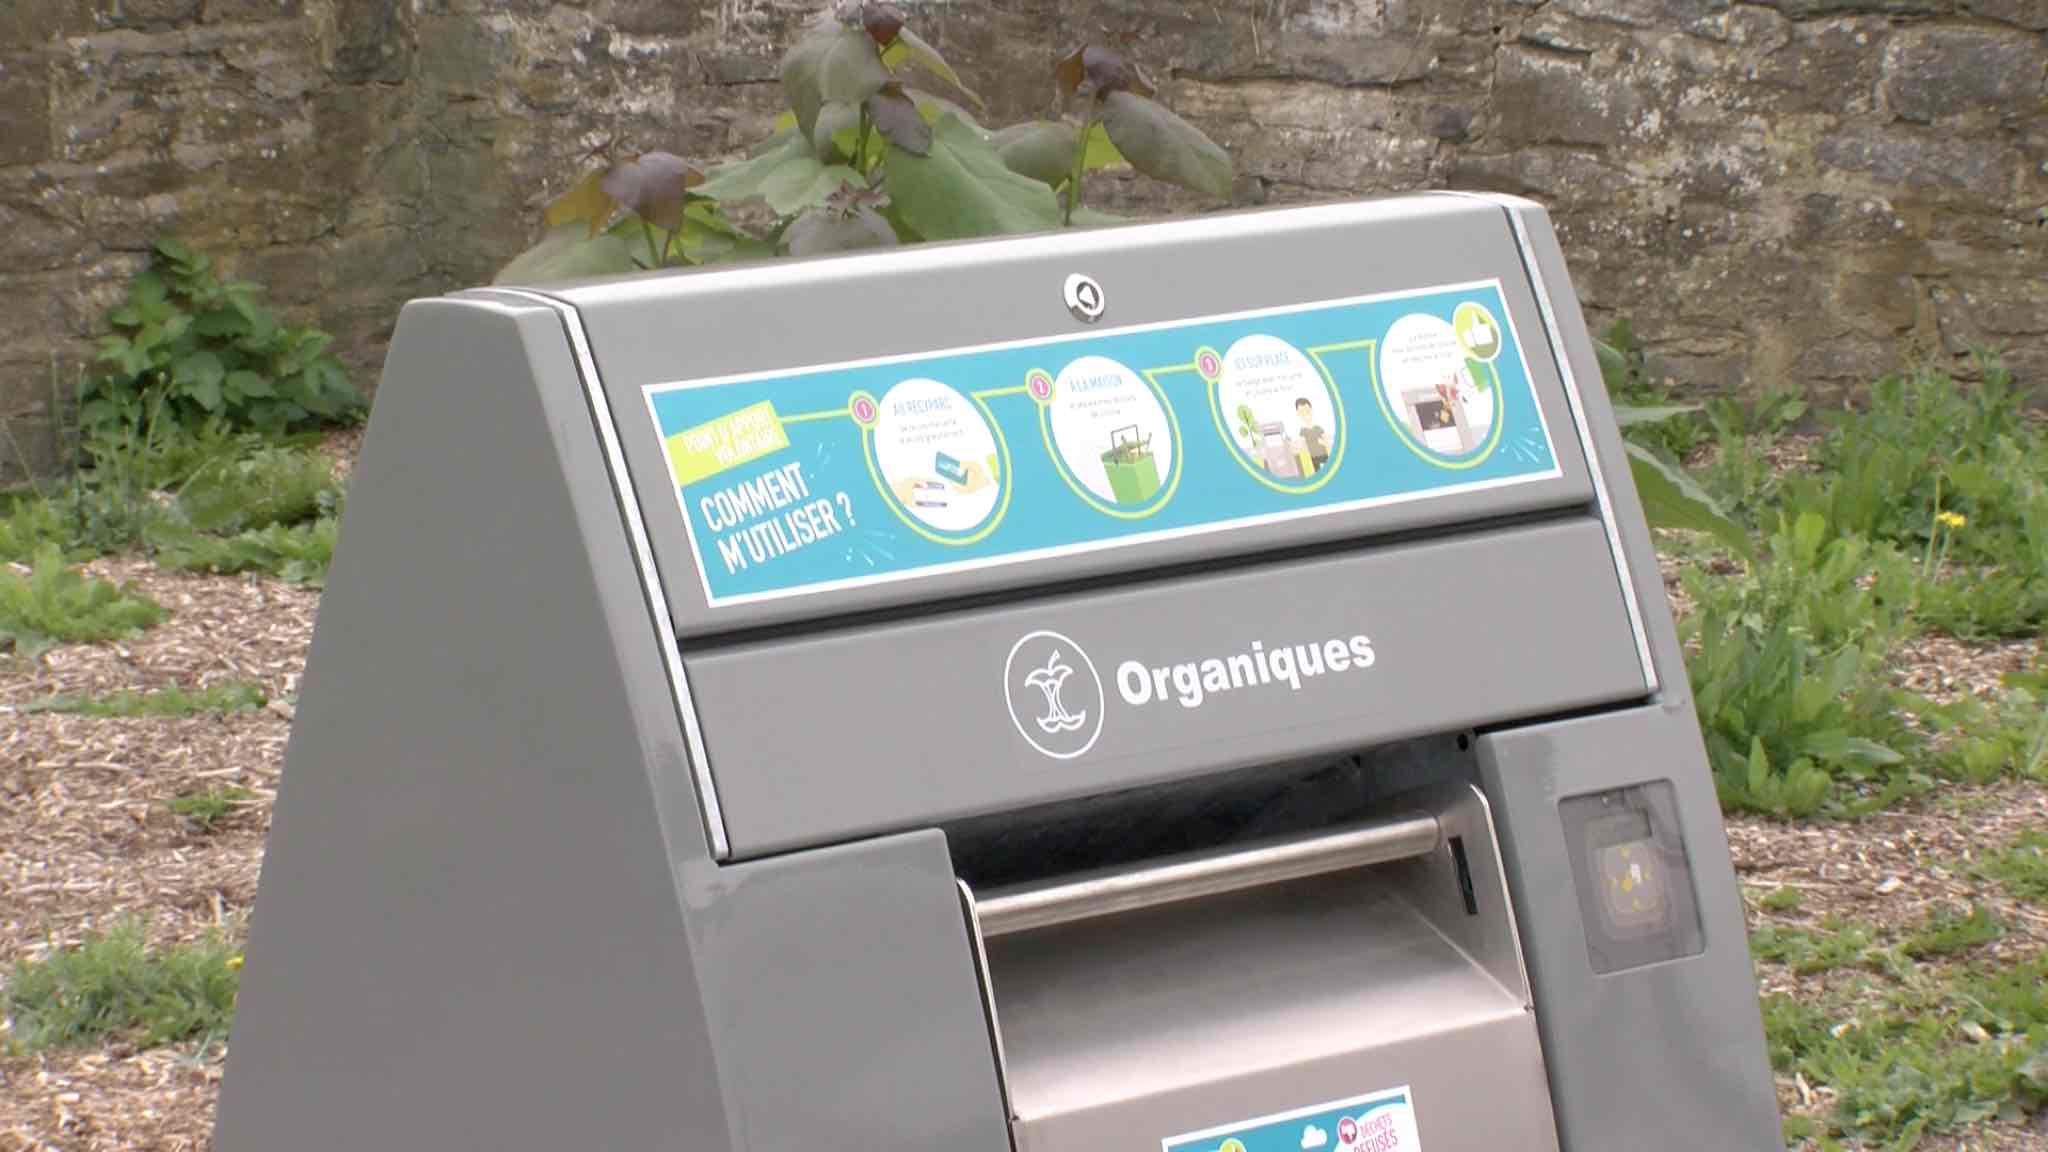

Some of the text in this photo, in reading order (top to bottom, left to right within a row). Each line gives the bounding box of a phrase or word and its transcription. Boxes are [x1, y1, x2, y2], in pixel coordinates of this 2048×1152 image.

[700, 462, 809, 532] COMMENT
[717, 492, 856, 575] M'UTILISER ?
[1116, 634, 1375, 707] Organiques
